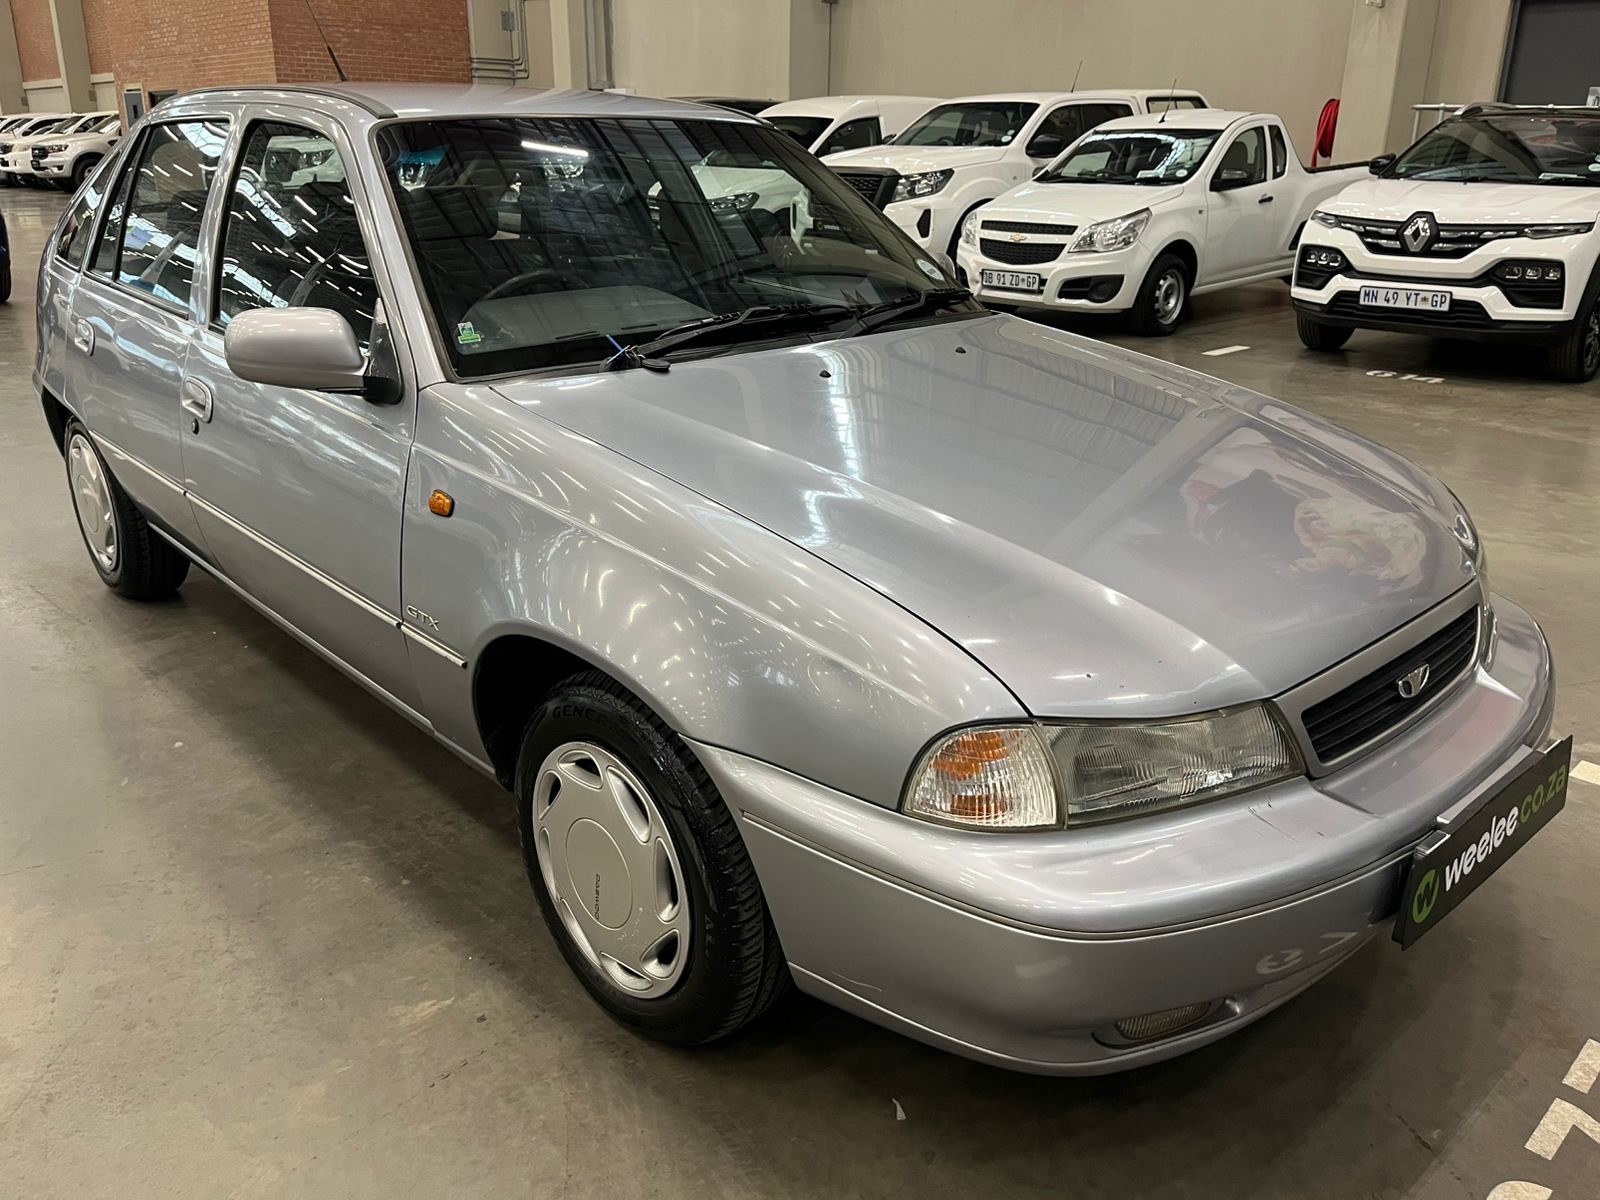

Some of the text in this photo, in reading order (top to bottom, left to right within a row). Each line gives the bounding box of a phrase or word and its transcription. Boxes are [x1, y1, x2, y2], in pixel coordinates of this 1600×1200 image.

[997, 273, 1006, 285] 91
[1026, 276, 1037, 289] GP
[1363, 289, 1447, 309] MN 49 YT GP
[406, 604, 440, 631] GTX
